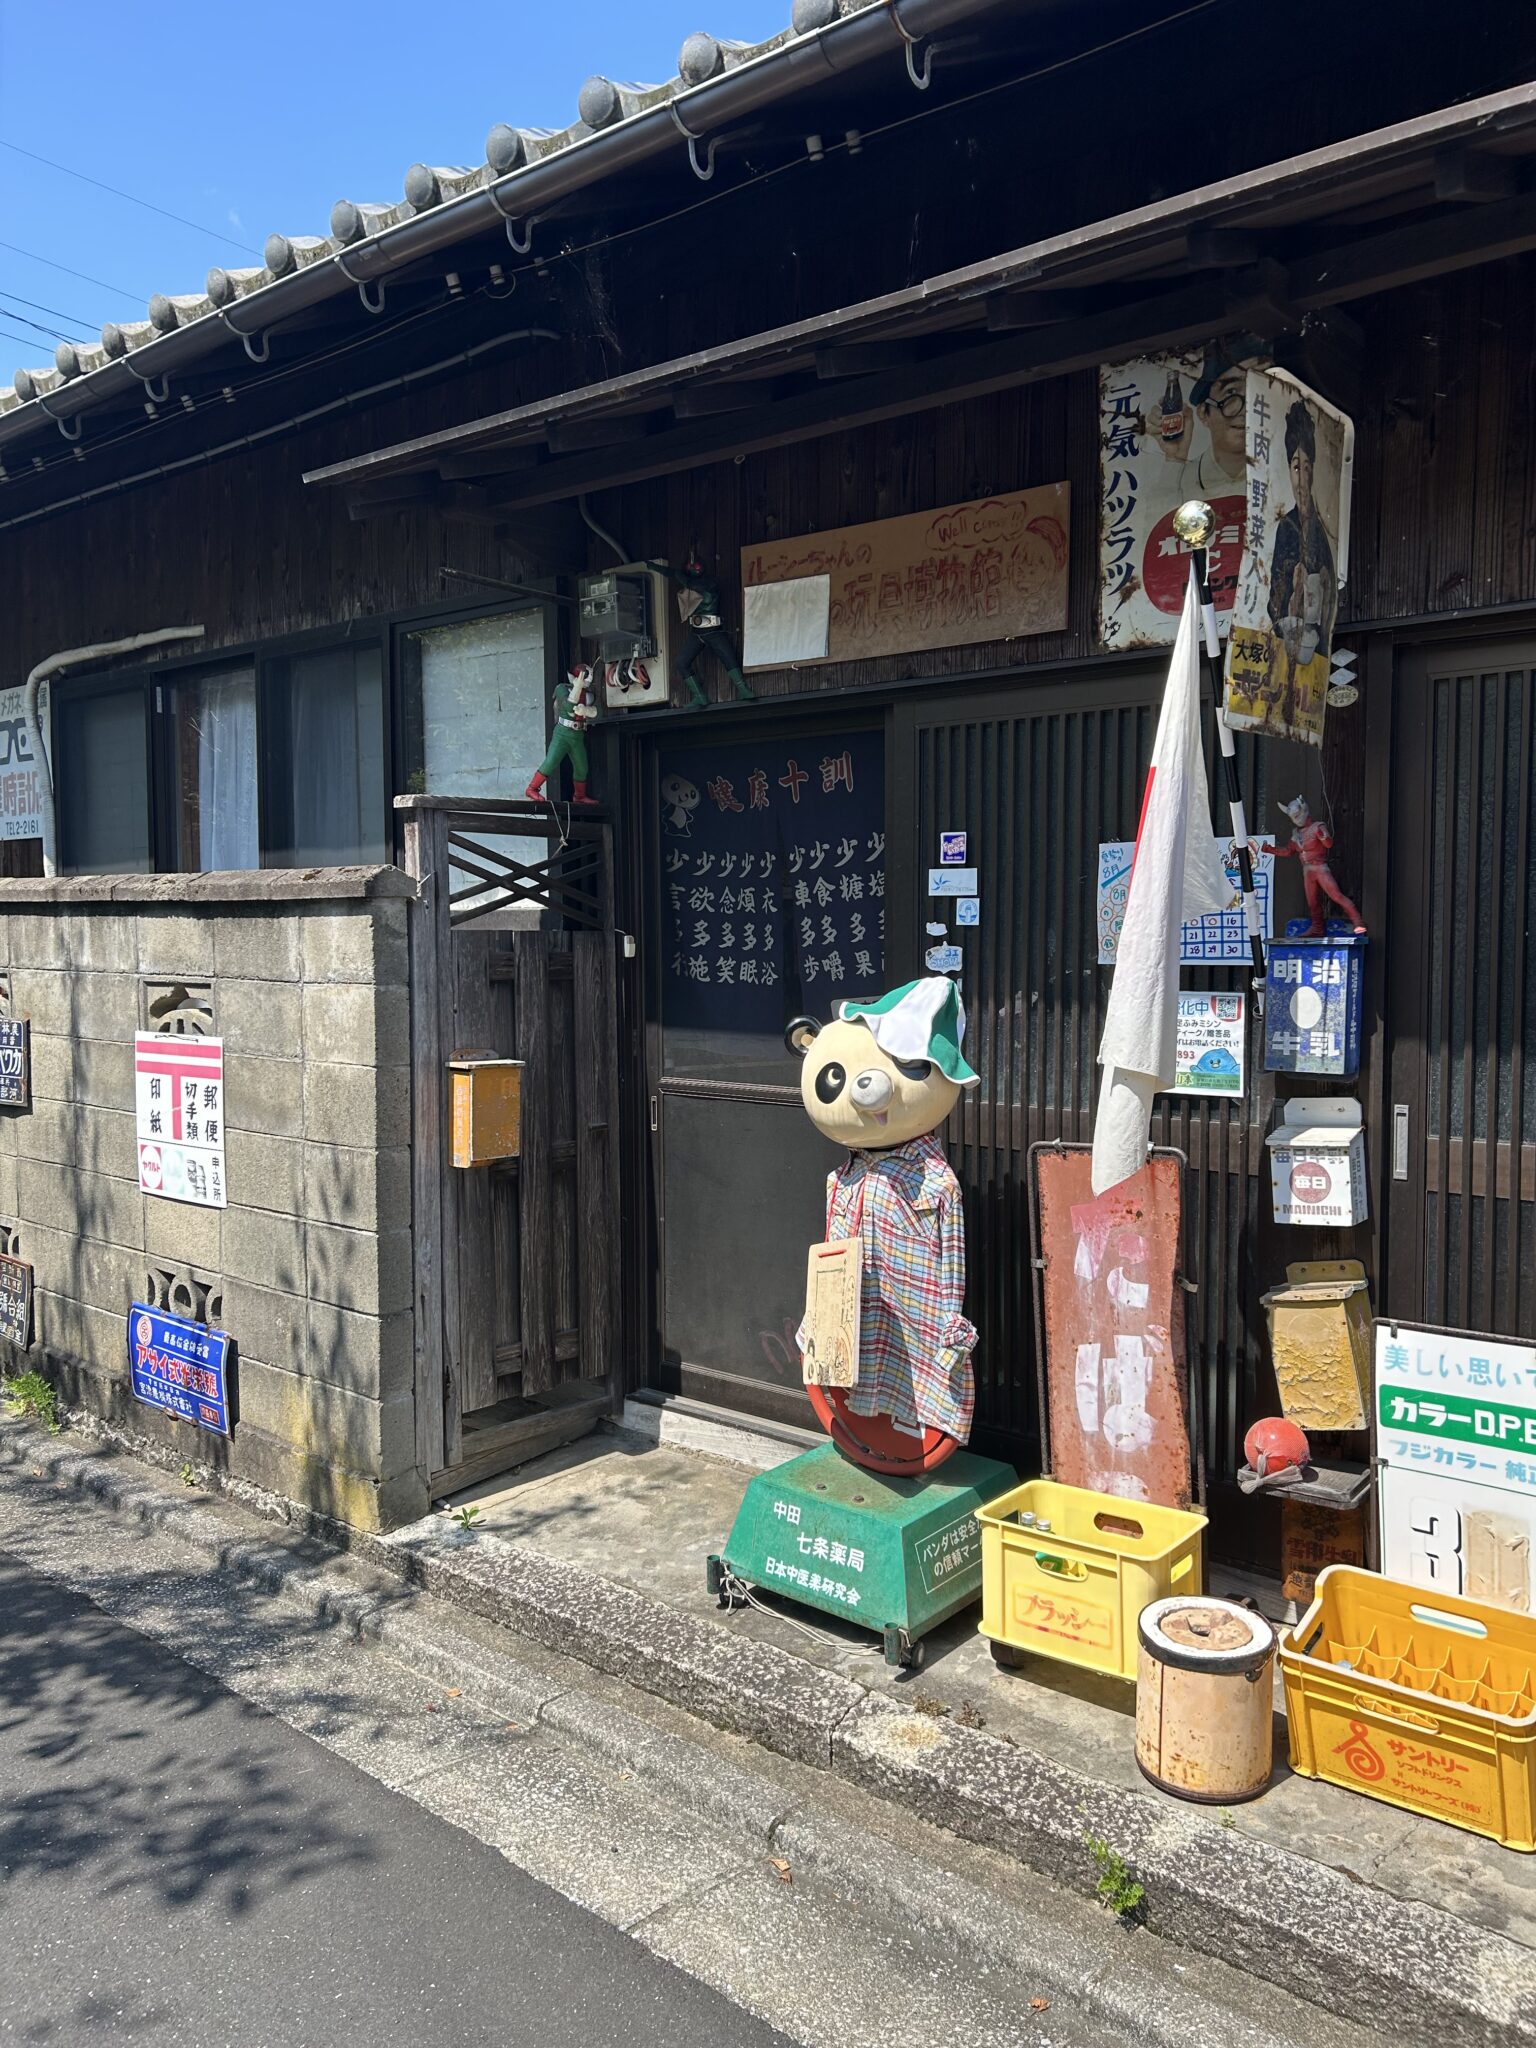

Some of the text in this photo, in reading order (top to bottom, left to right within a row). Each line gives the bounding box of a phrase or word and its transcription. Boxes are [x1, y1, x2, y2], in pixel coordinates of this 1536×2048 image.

[1273, 958, 1341, 984] 明治
[149, 1077, 163, 1134] 印紙
[1282, 1204, 1342, 1216] MAINICHI
[773, 1501, 801, 1525] 中田
[796, 1532, 865, 1573] 七条薬局
[933, 1535, 982, 1577] の信頼マー
[764, 1556, 862, 1607] 日本中医薬研究会
[1386, 1738, 1470, 1773] サントリー
